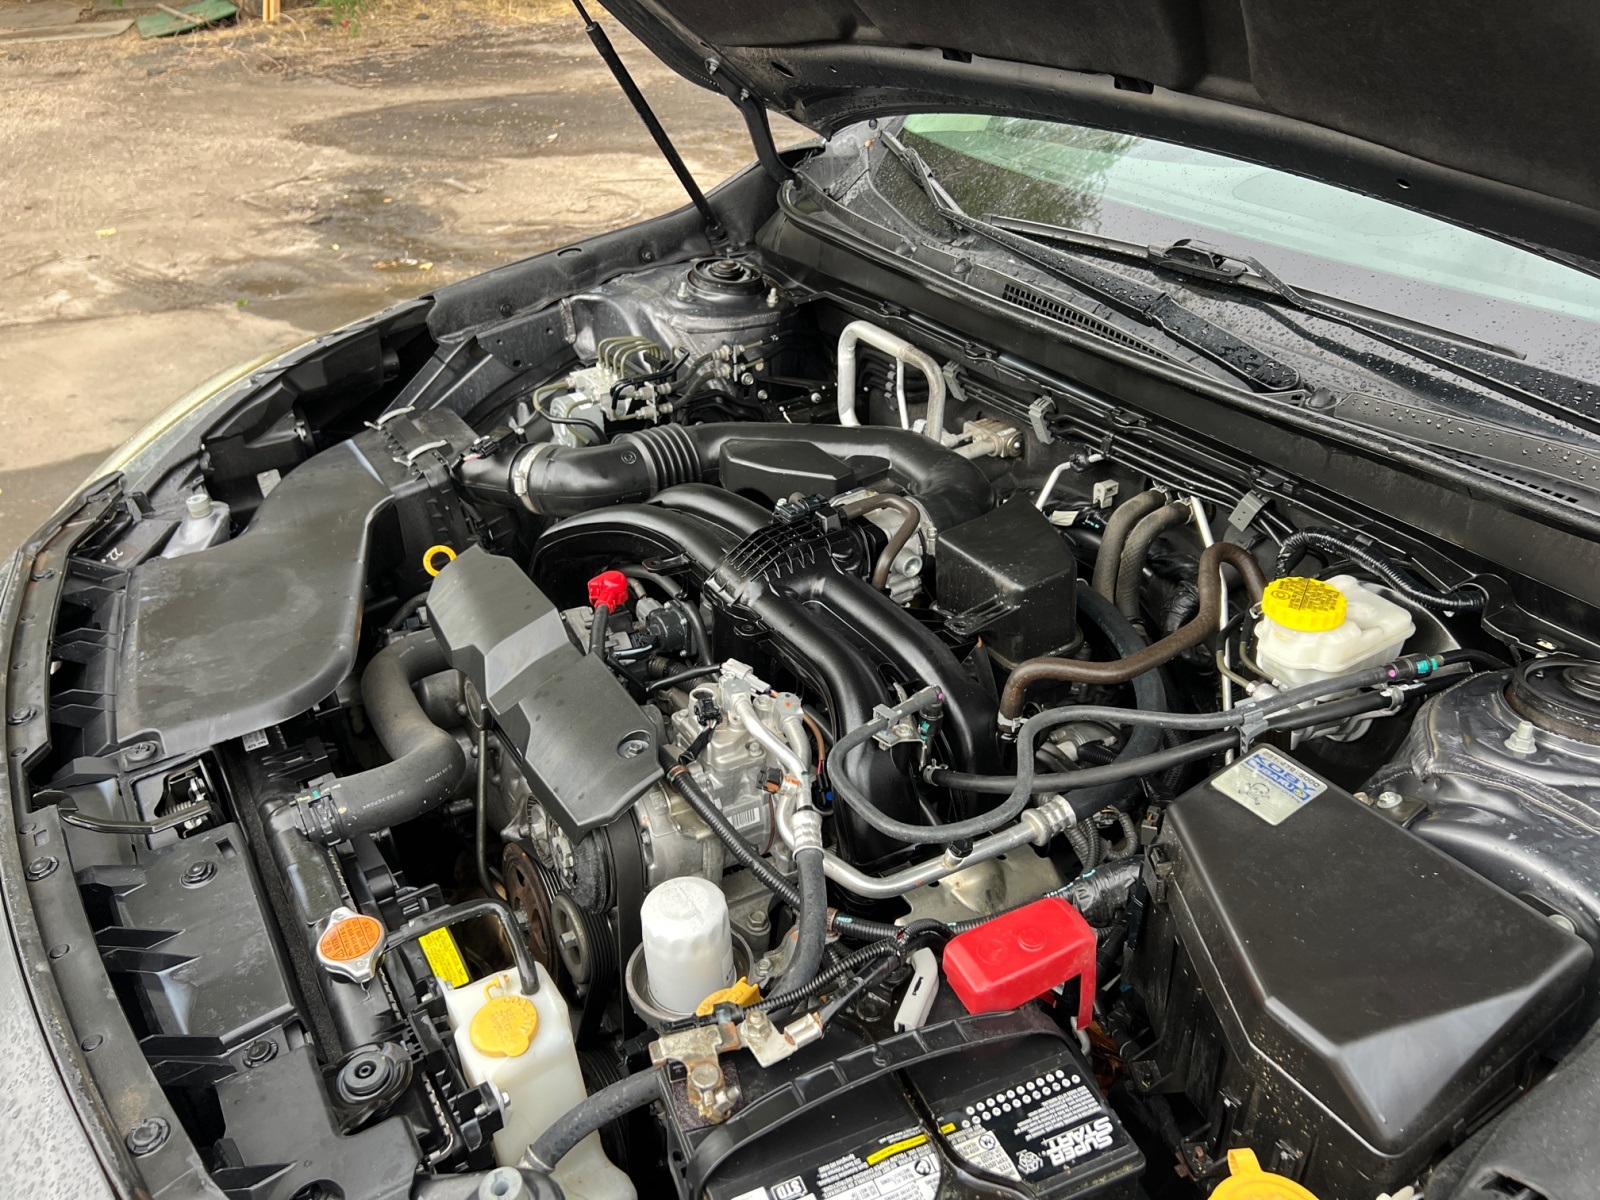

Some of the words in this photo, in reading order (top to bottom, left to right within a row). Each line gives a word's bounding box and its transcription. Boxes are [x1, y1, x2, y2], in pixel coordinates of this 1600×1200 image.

[1247, 760, 1295, 790] SUBARU
[1252, 753, 1317, 792] KOBY
[1047, 1116, 1113, 1155] START
[1050, 1134, 1113, 1167] SUPER
[777, 1179, 802, 1198] STD
